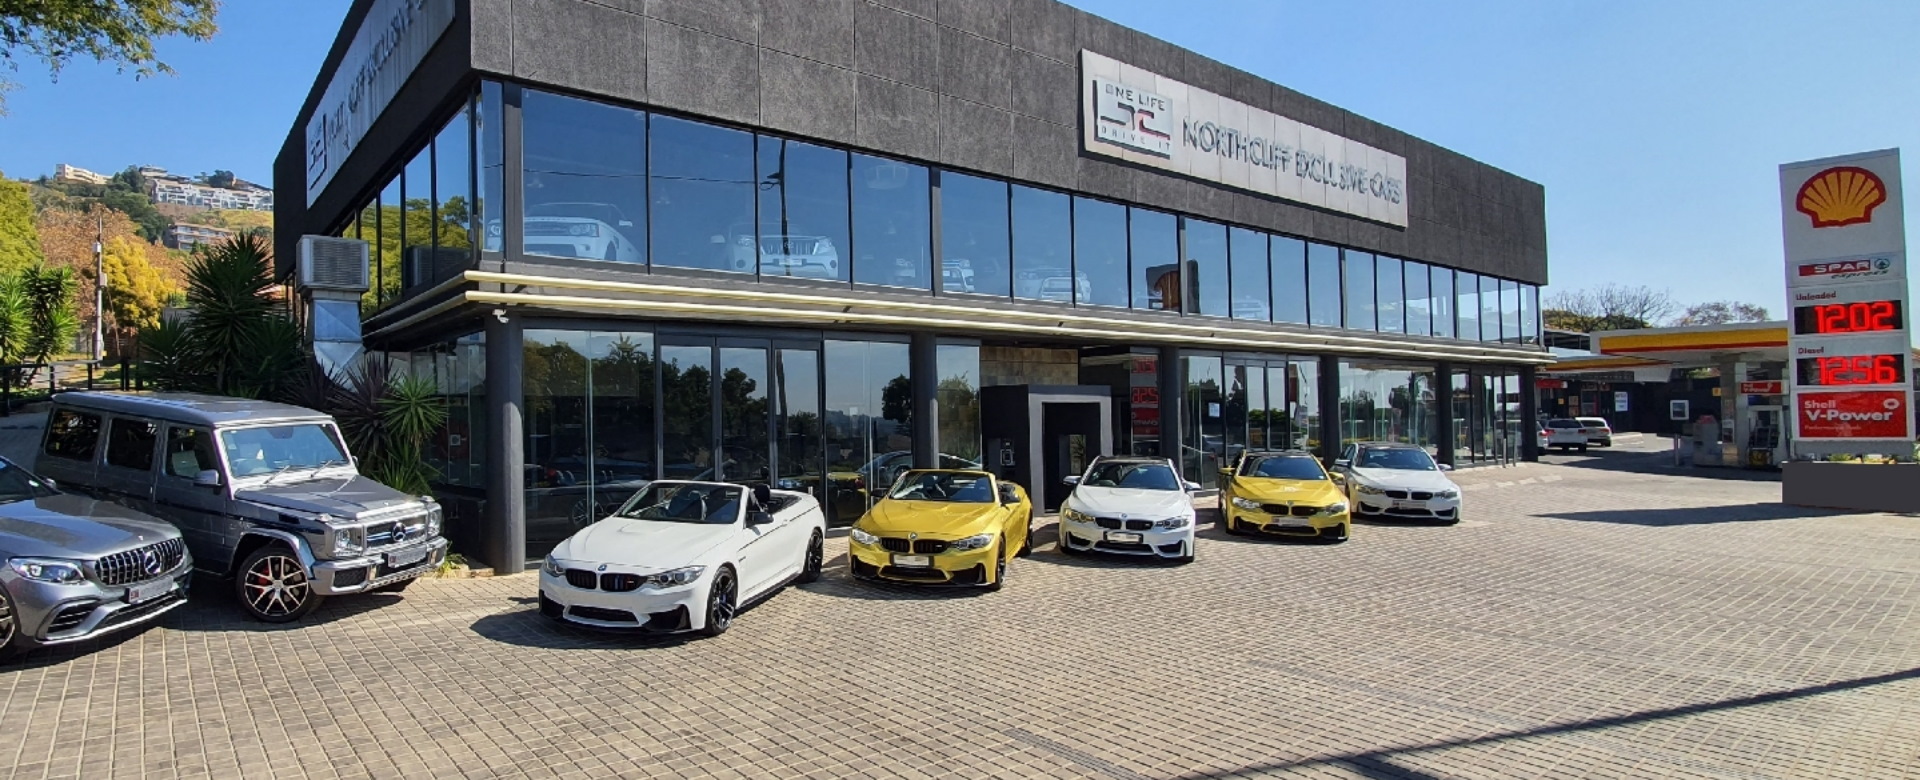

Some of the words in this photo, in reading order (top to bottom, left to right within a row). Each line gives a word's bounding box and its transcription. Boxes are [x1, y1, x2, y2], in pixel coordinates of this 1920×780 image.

[1105, 83, 1133, 102] ONE
[1138, 93, 1165, 112] LIFE
[1101, 125, 1146, 145] DRIVE
[1158, 141, 1171, 151] IT
[1182, 116, 1293, 173] NORTHCLIFF
[1295, 150, 1368, 194] EXCLUSIVE
[1370, 171, 1402, 205] CARS
[1814, 261, 1870, 274] SPAR
[1795, 291, 1836, 300] Unleaded
[1798, 346, 1824, 354] Diesel
[1804, 400, 1836, 409] Shell
[1805, 409, 1893, 421] V-Power
